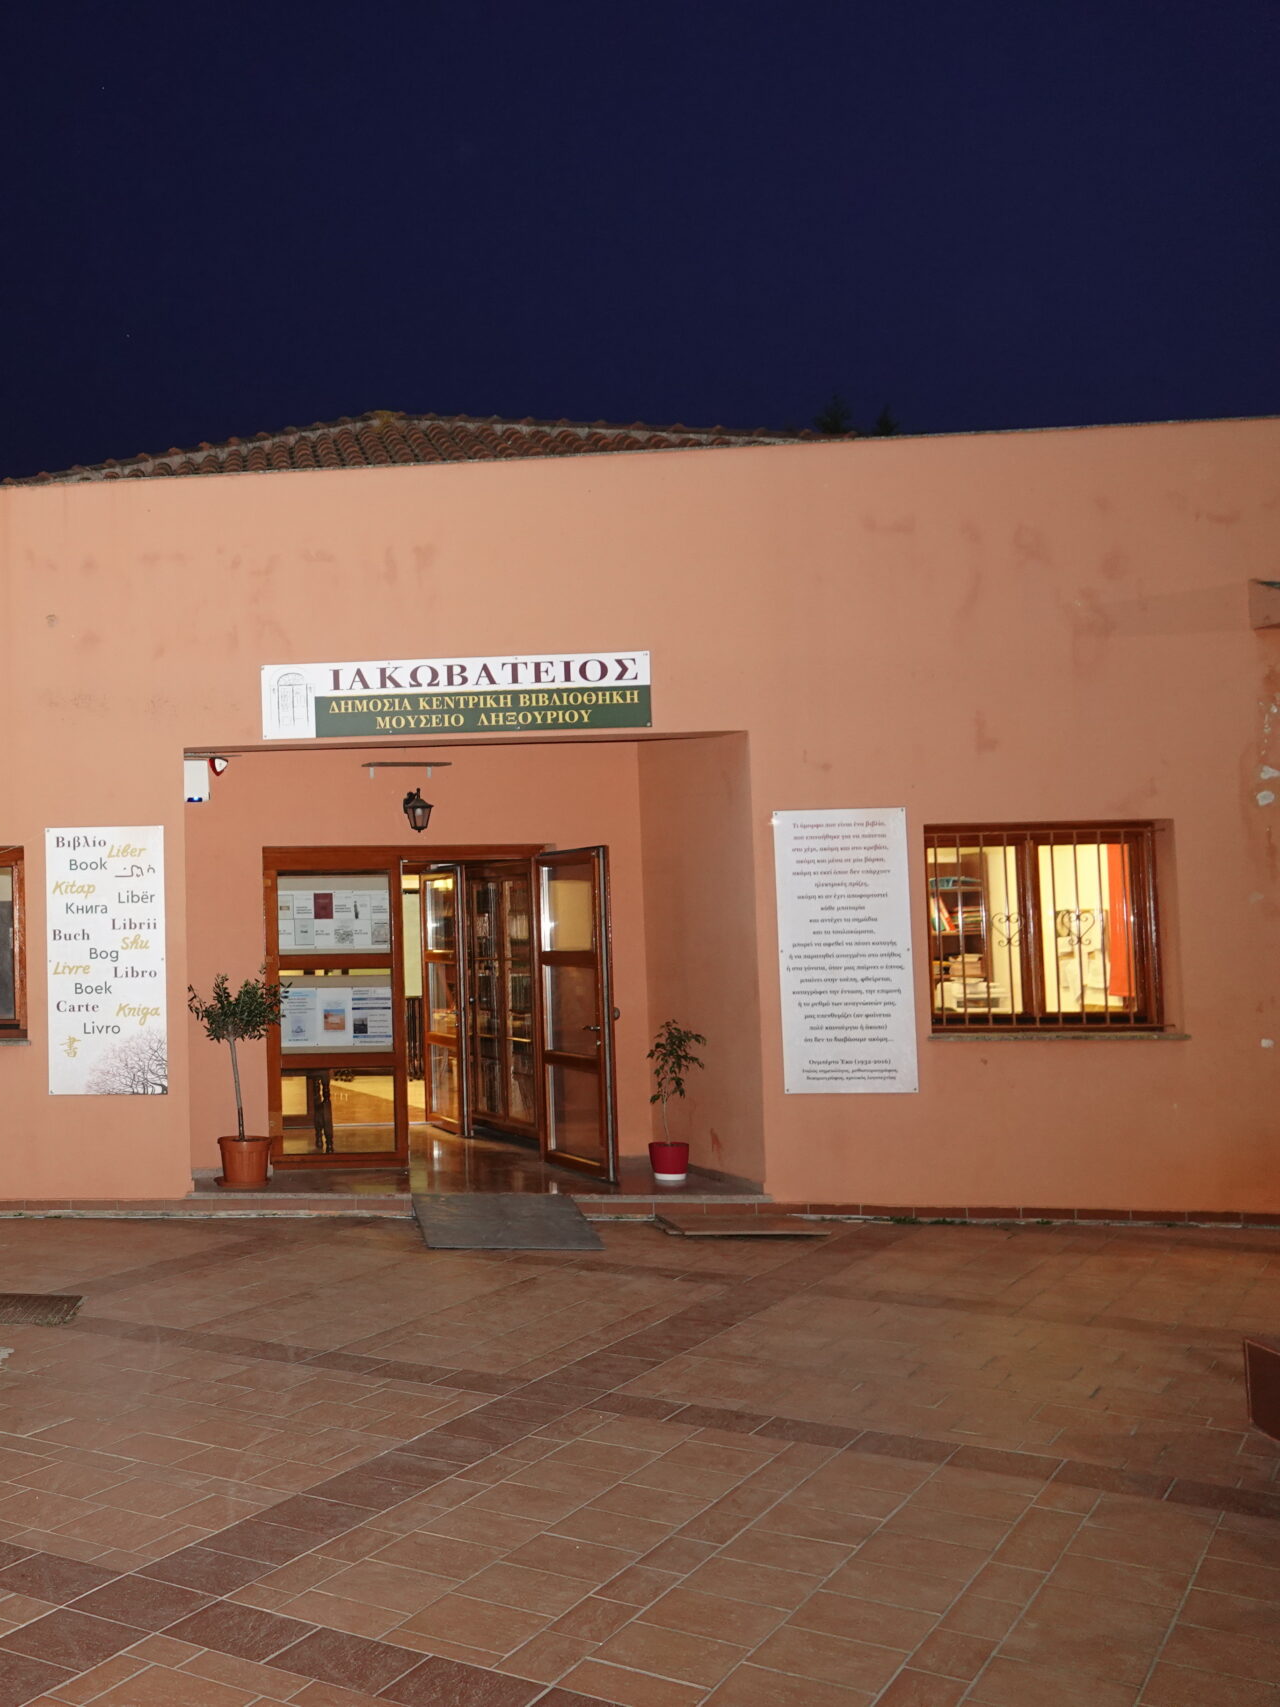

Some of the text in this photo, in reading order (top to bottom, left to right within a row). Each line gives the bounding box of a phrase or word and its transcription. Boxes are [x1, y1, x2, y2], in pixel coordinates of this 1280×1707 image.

[329, 658, 638, 691] ΙΑΚΩΒΑΤΕΙΟΣ
[329, 690, 639, 713] ΔΗΜΟΣΙΑ ΚΕΝΤΡΙΚΗ ΒΙΒΛΙΟΘΗΚΗ
[376, 710, 592, 729] ΜΟΥΣΕΙΟ ΛΗΞΟΥΡΙΟΥ
[56, 836, 107, 850] Βιβλίο
[107, 844, 146, 858] Liber
[69, 857, 107, 870] Book
[52, 881, 96, 899] Kitap
[118, 891, 155, 903] Libër
[66, 902, 108, 914] Книга
[112, 918, 157, 930] Librii
[53, 929, 90, 941] Buch
[121, 934, 150, 950] Shu
[89, 948, 119, 962] Bog
[53, 962, 91, 975] Livre
[114, 966, 157, 978] Libro
[75, 981, 112, 994] Boek
[56, 1000, 99, 1012] Carte
[116, 1003, 160, 1026] Kniga
[84, 1021, 120, 1034] Livro
